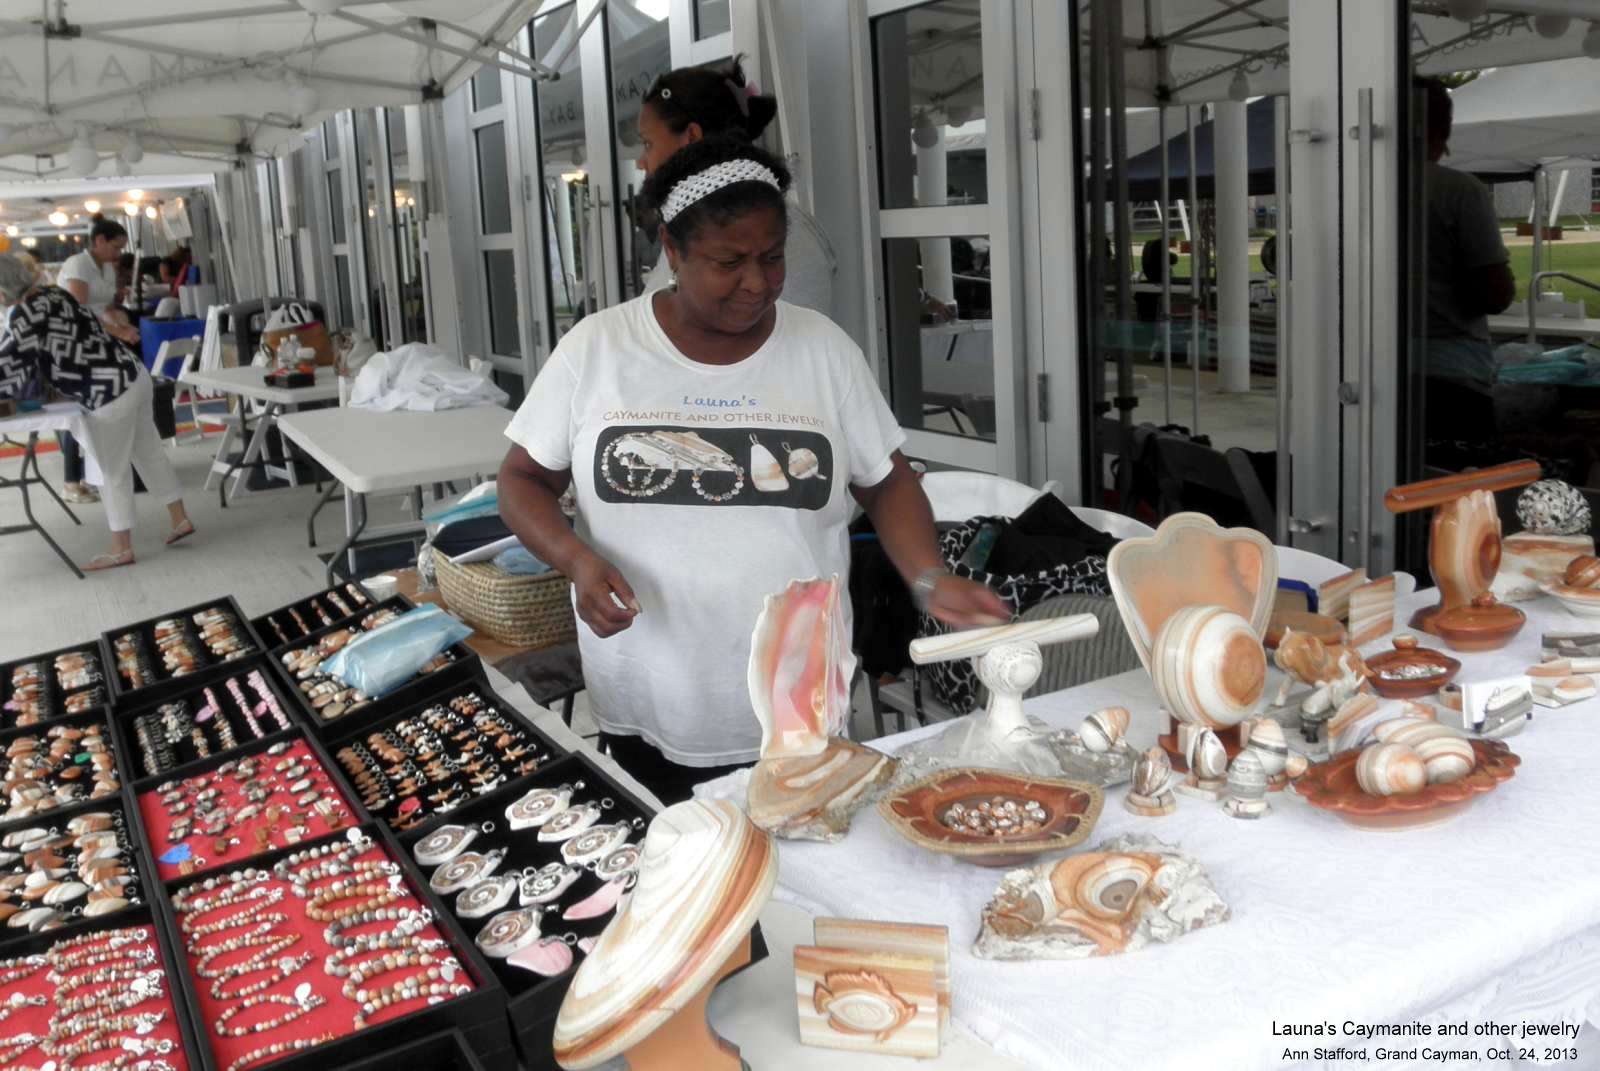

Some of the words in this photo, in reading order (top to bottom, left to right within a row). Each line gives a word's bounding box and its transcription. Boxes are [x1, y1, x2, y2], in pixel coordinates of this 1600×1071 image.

[682, 395, 758, 408] Launa's
[603, 410, 681, 421] CAYMANITE
[686, 413, 720, 422] AND
[723, 412, 774, 423] OTHER
[776, 414, 825, 428] JEWELRY
